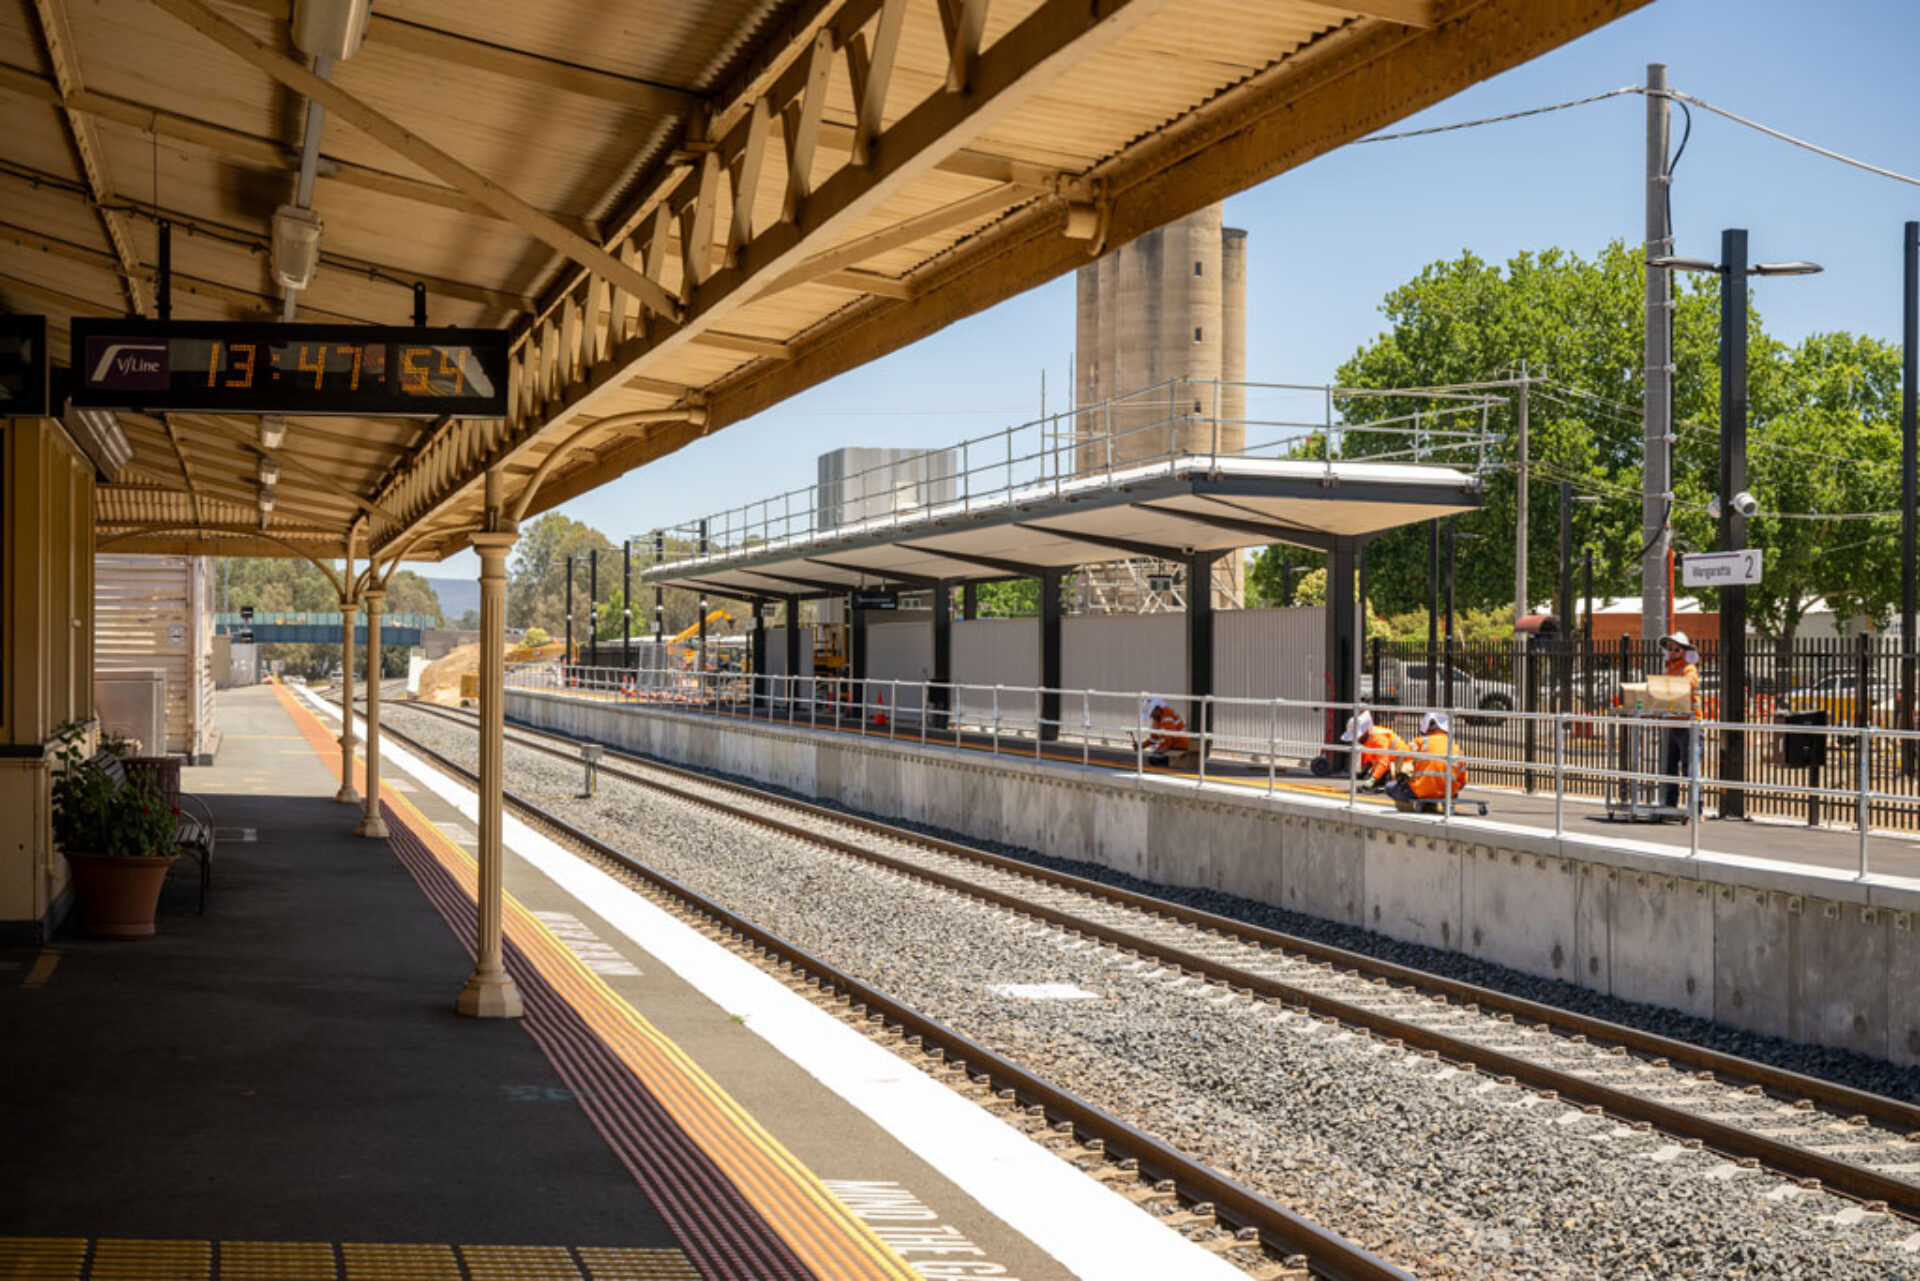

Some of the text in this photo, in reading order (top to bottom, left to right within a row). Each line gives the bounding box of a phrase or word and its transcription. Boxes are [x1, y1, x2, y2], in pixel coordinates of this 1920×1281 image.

[1744, 554, 1755, 579] 2
[821, 1179, 939, 1220] MIND
[868, 1224, 987, 1256] THE
